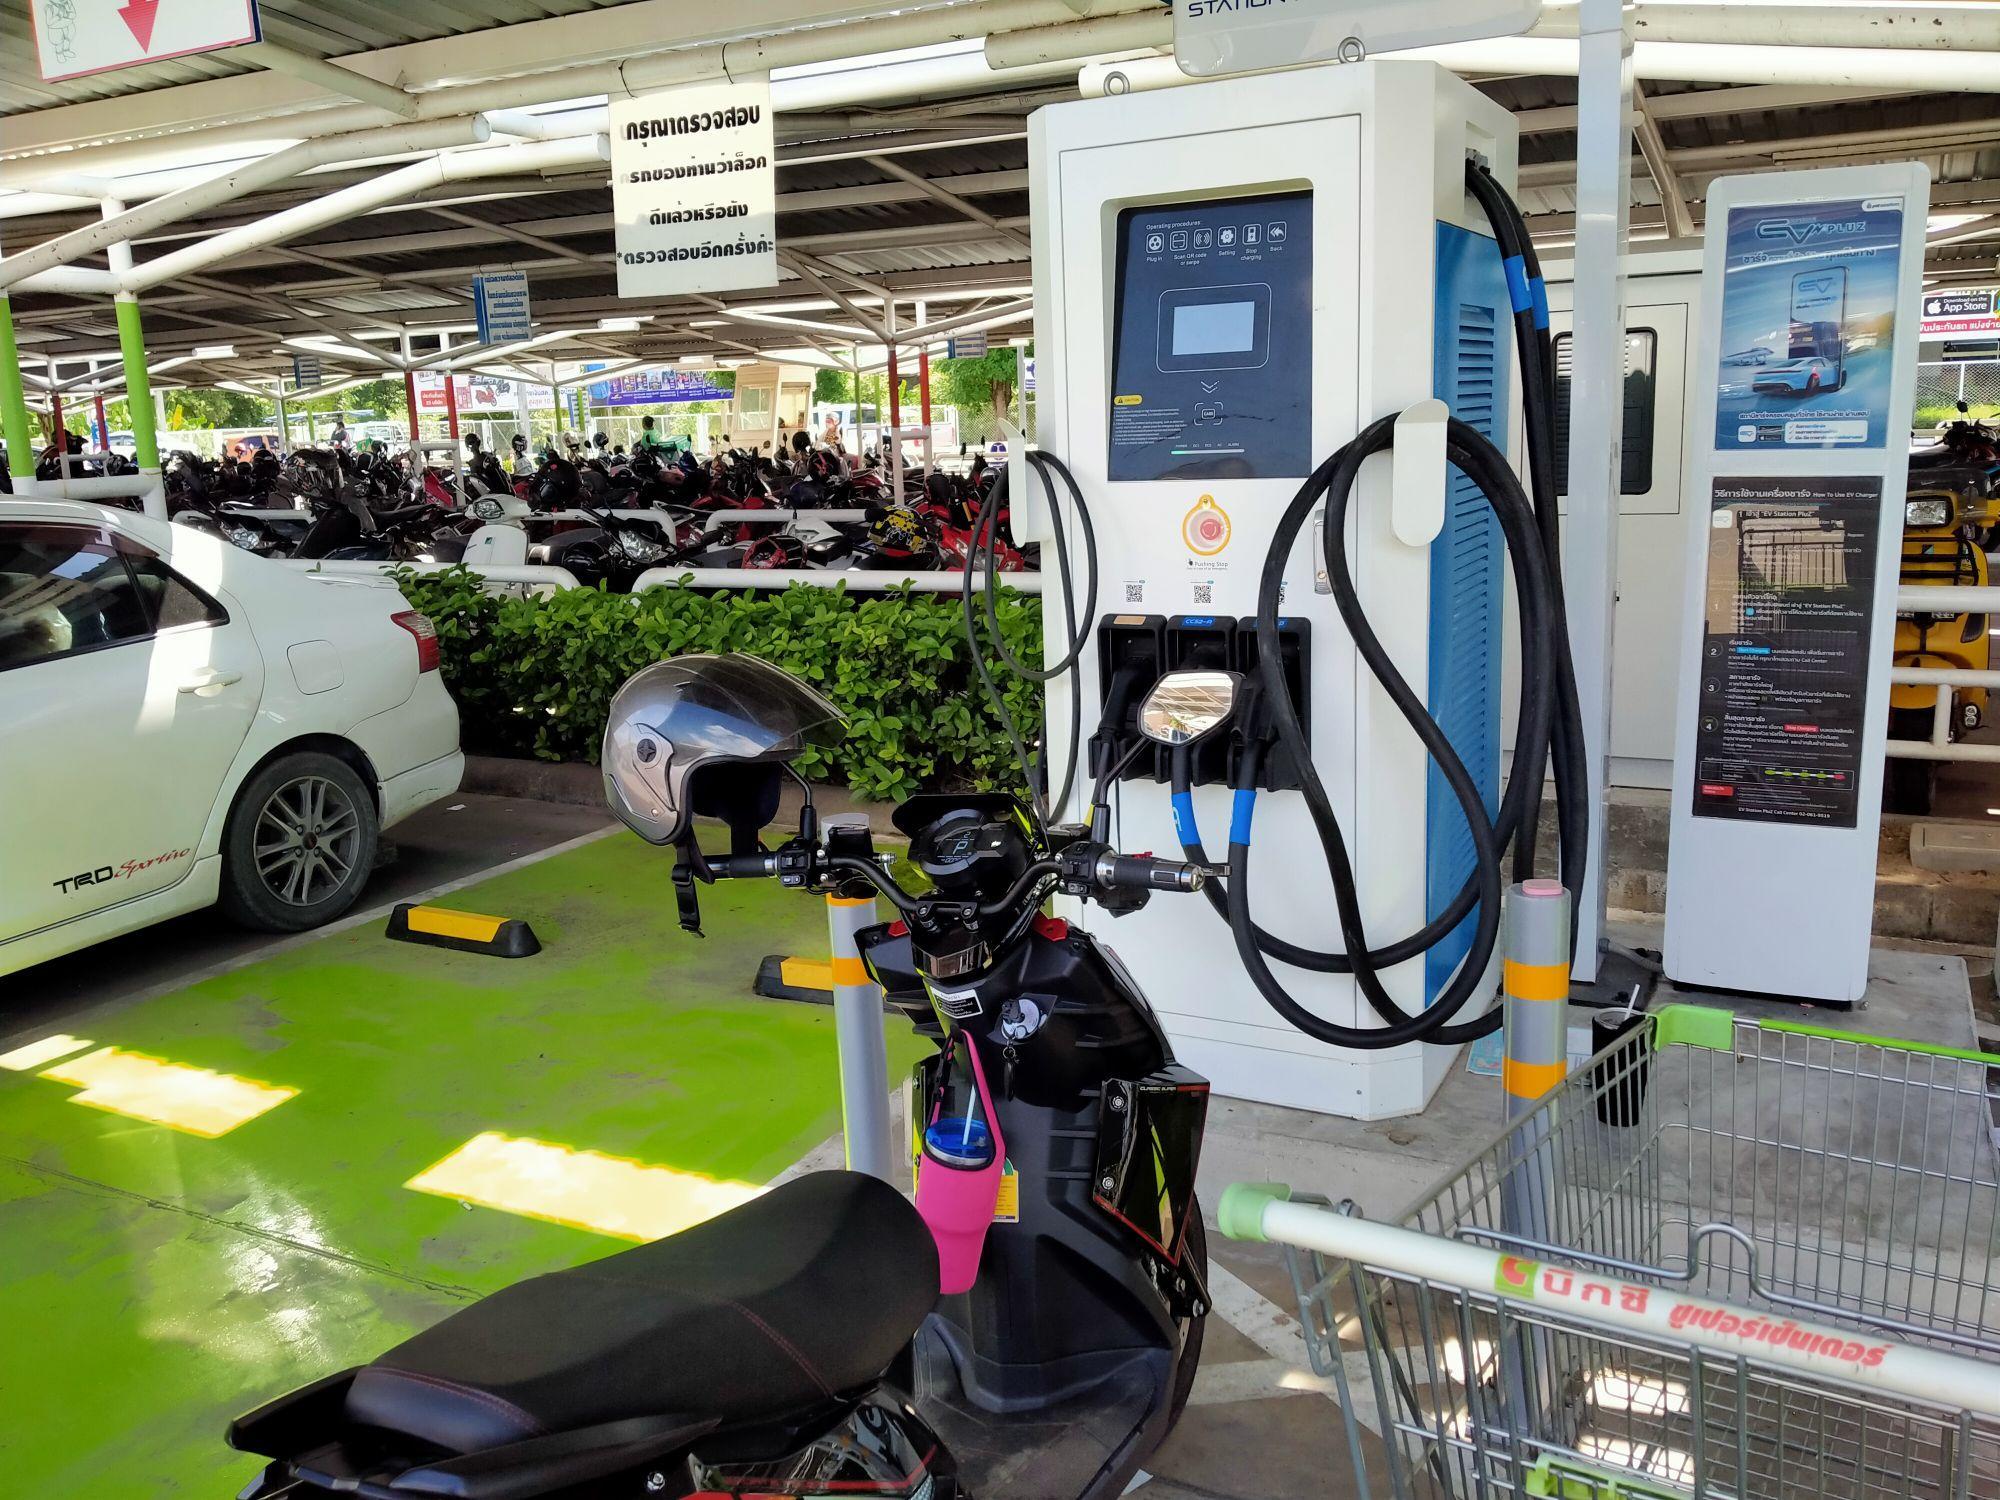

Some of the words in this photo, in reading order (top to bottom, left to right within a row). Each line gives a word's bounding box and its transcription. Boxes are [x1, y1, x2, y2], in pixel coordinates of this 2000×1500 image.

[1188, 0, 1286, 18] STATIO
[1146, 223, 1171, 231] Operating
[1826, 221, 1866, 234] PLUZ
[1943, 304, 1963, 313] App
[1963, 302, 1988, 310] Store
[1710, 648, 1717, 656] 2
[1708, 684, 1715, 692] 3
[1706, 722, 1712, 730] 4
[952, 841, 969, 855] P
[53, 865, 114, 895] TRD
[113, 847, 191, 880] Sportivo
[1667, 1301, 1897, 1368] ซูเปอร์เซ็นเตอร์
